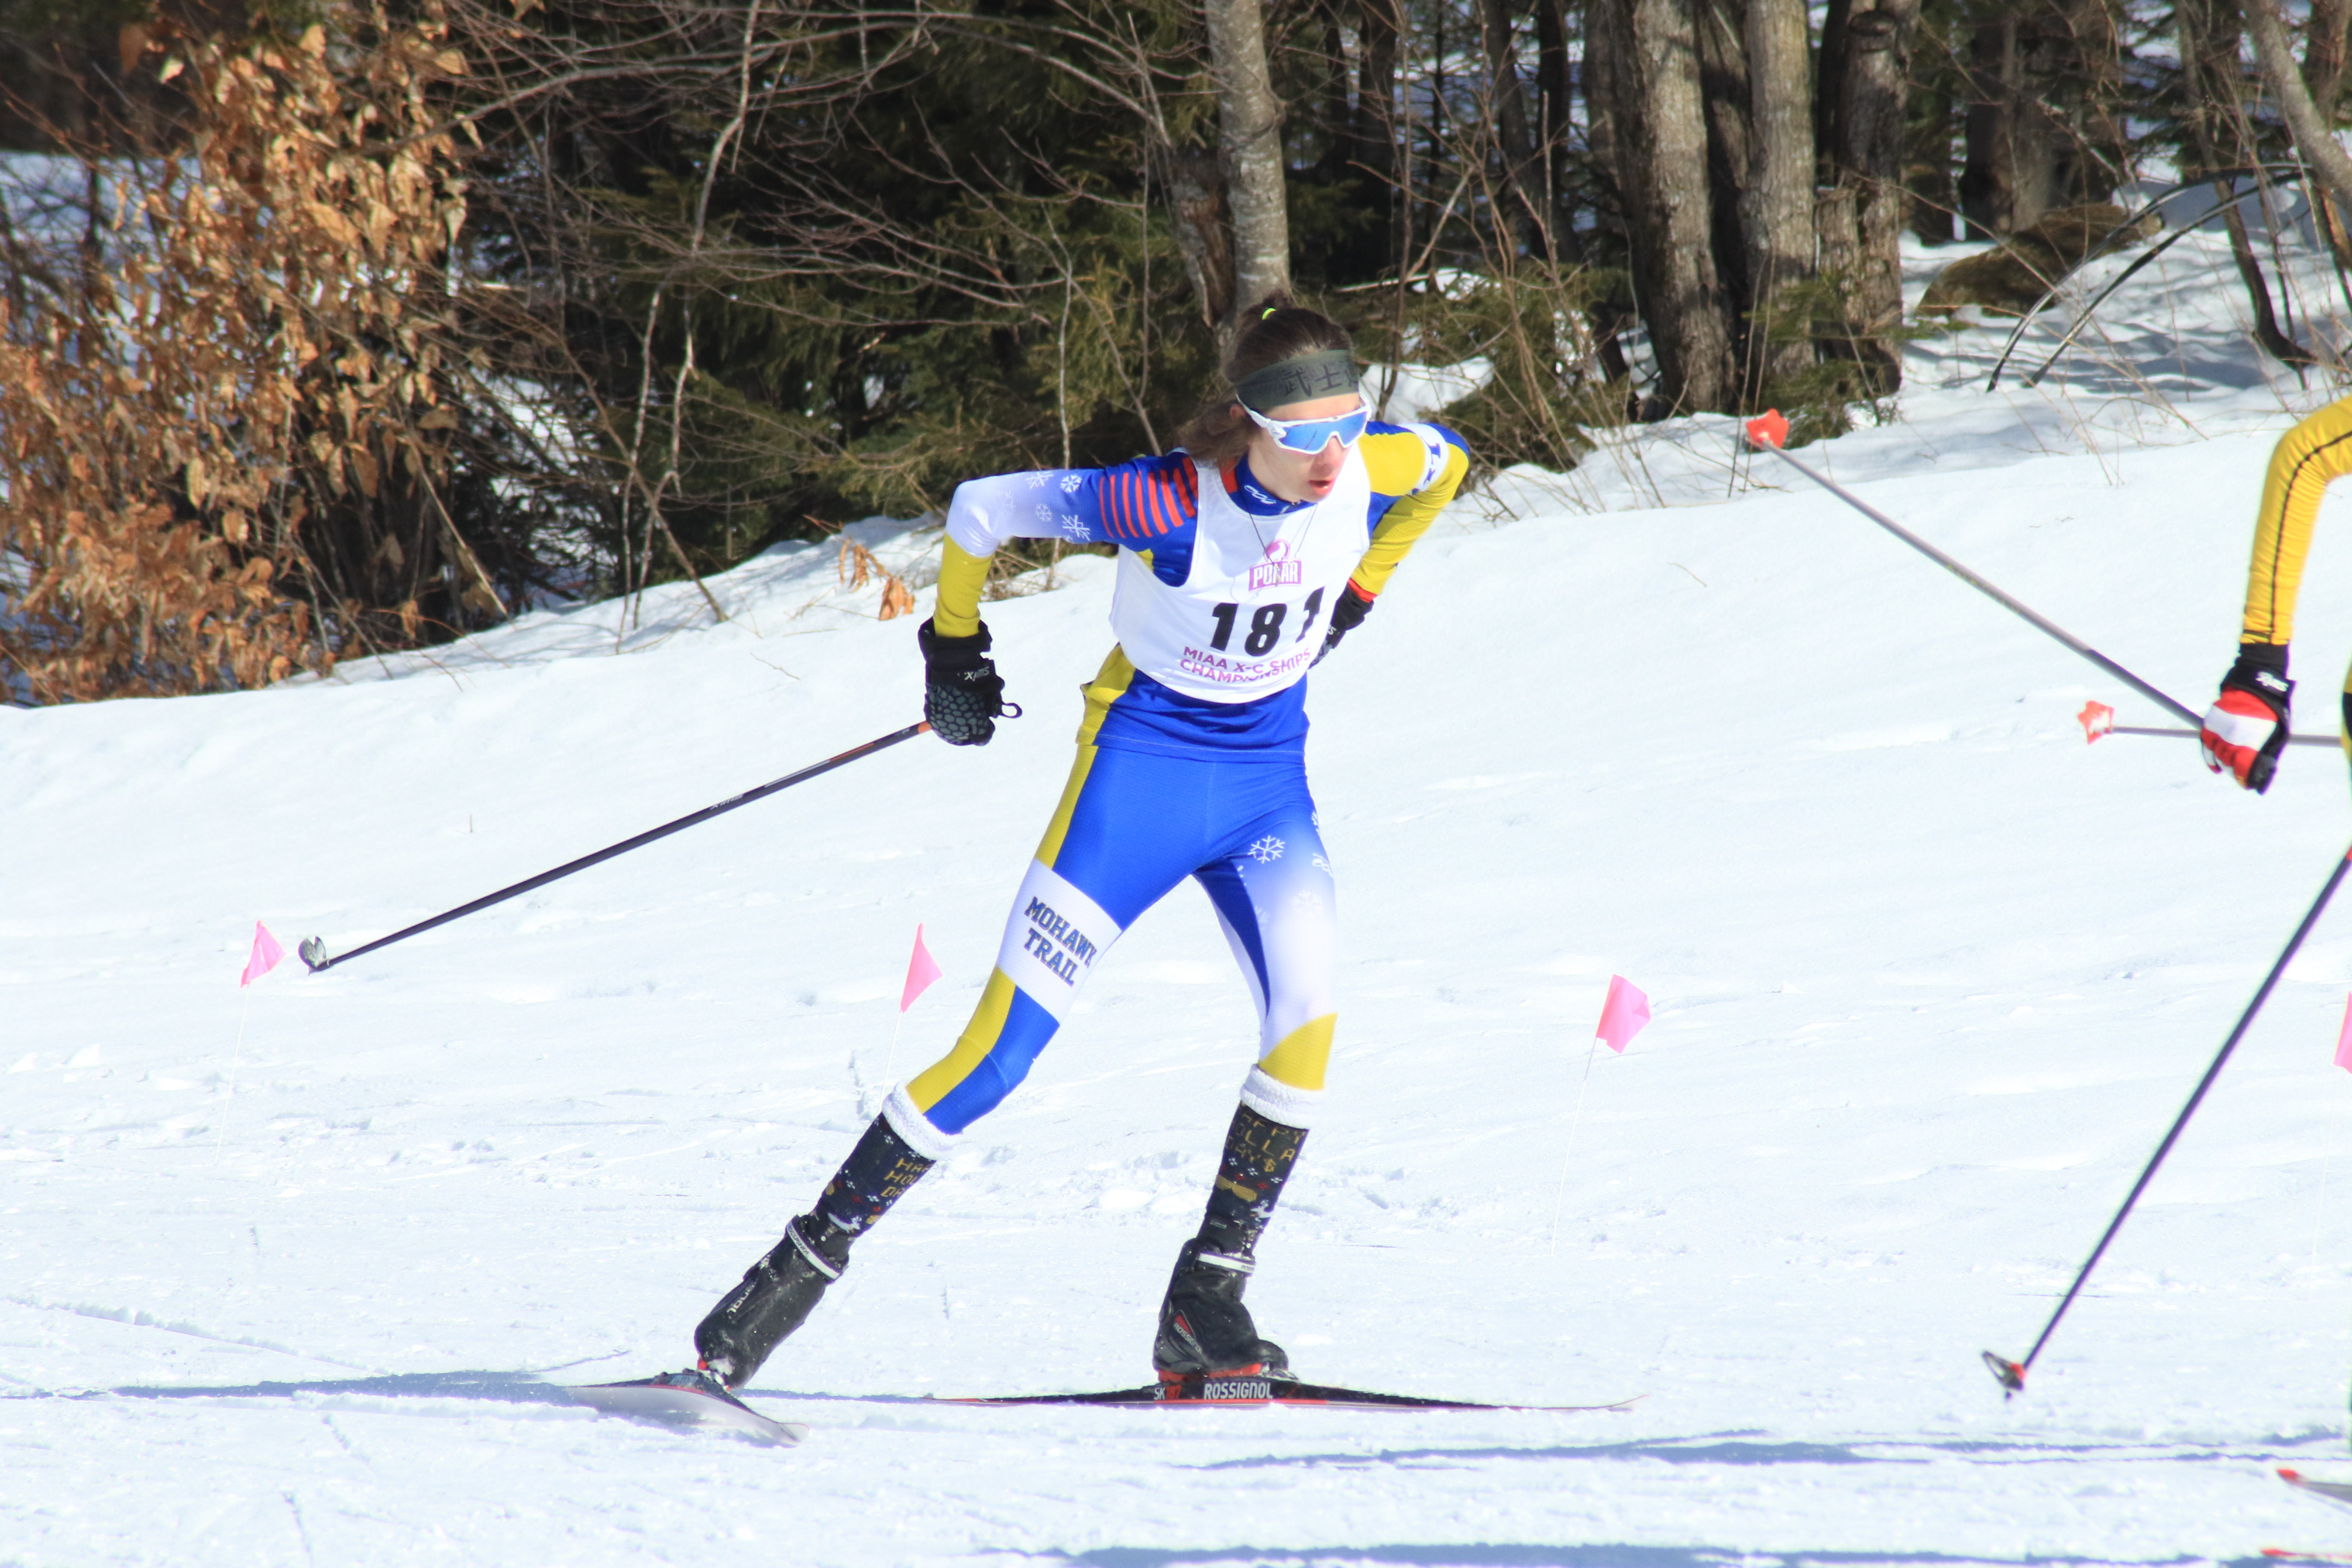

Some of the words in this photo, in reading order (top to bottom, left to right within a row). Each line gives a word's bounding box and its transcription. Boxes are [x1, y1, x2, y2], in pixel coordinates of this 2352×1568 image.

[1210, 586, 1325, 657] 181
[1183, 646, 1228, 670] MIAA
[1234, 662, 1264, 675] X-C
[1023, 927, 1078, 987] TRAIL
[1024, 896, 1097, 968] MOHAWK
[1204, 1382, 1274, 1400] ROSSIGNOL
